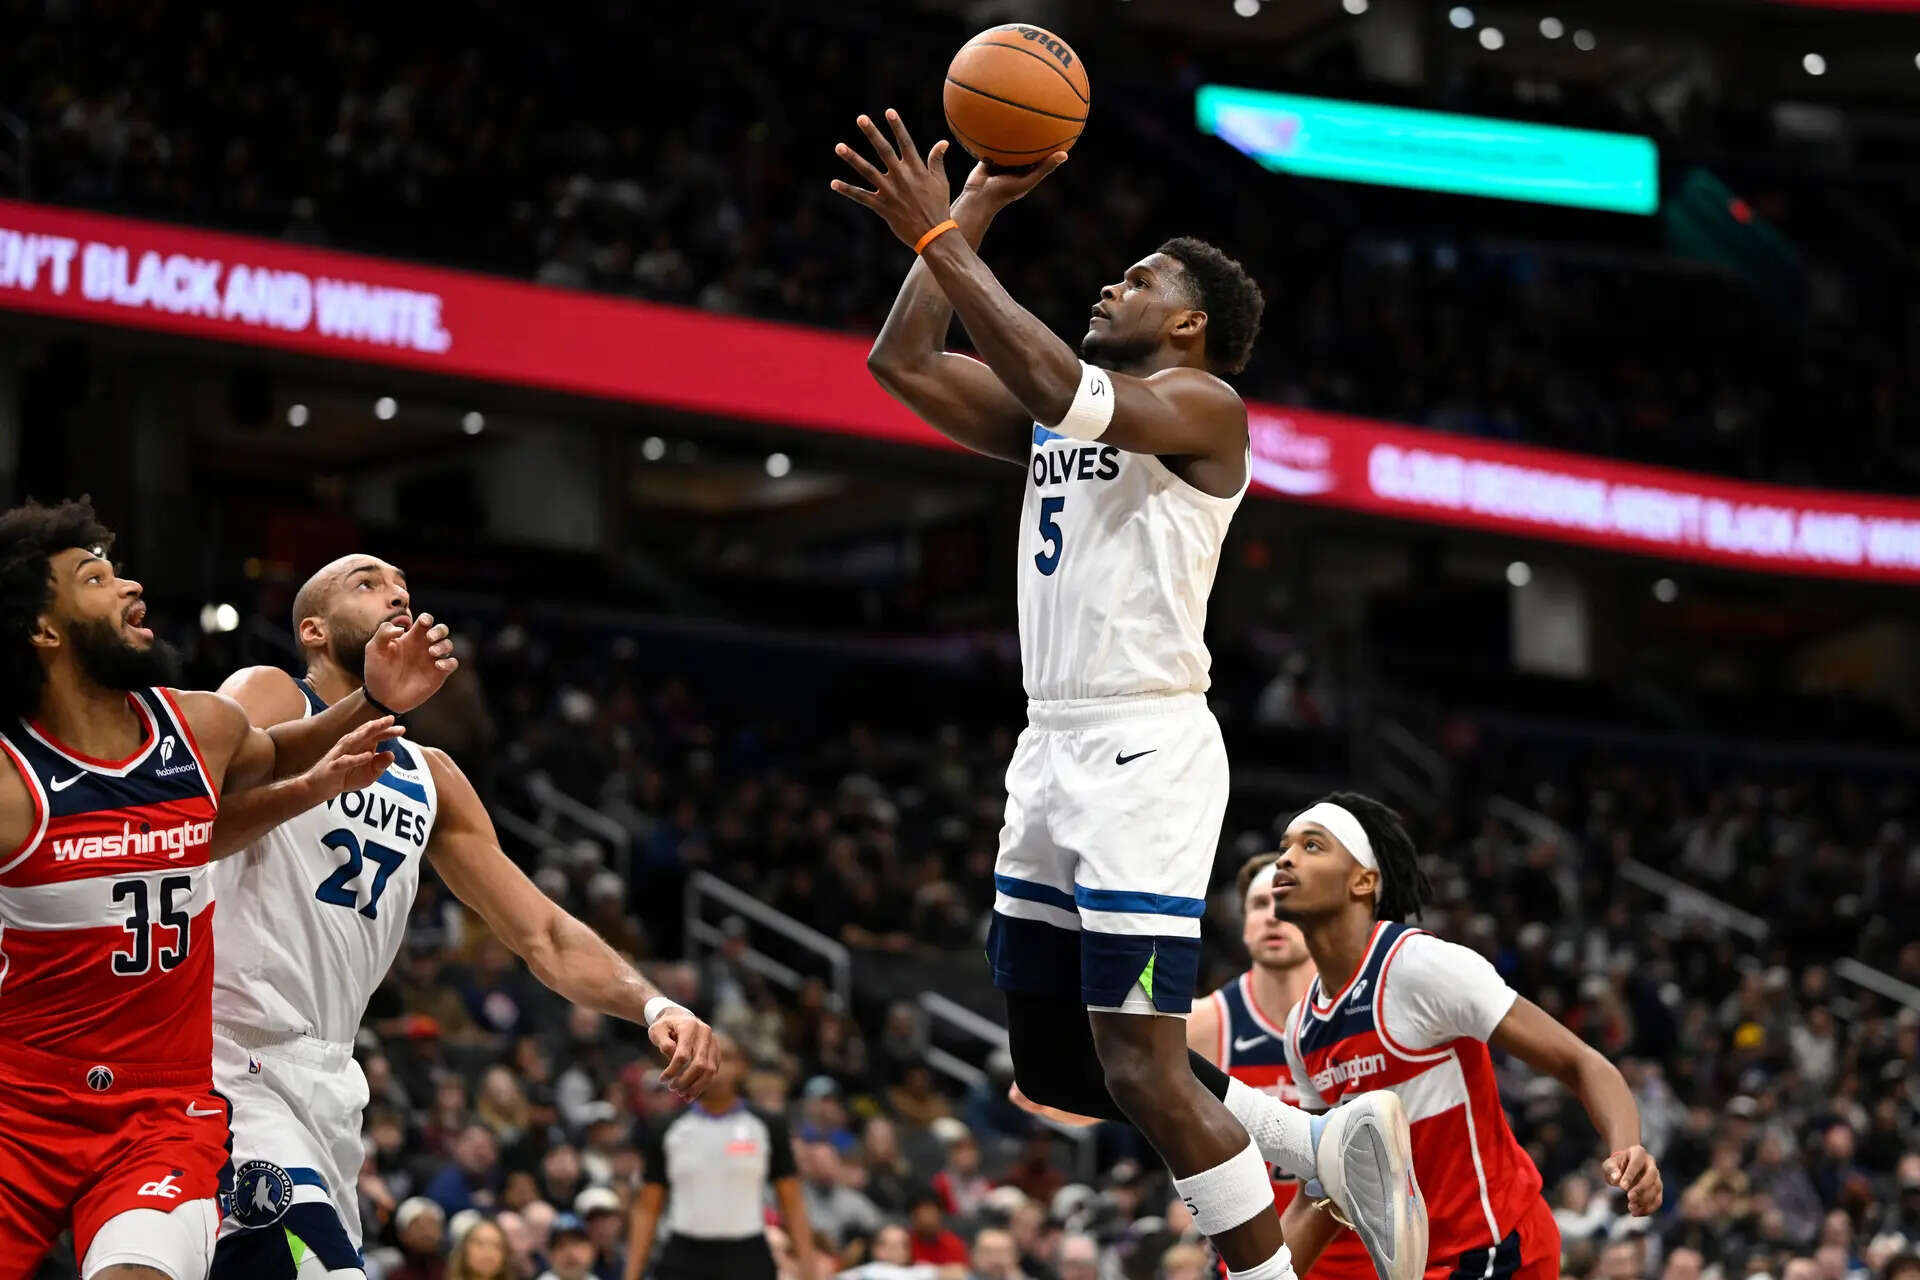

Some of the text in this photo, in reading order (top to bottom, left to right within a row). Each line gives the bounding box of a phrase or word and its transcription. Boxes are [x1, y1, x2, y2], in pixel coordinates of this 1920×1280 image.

[82, 241, 222, 318] BLACK
[222, 263, 312, 332] AND
[1034, 496, 1066, 576] 5
[155, 761, 196, 777] Robinhood
[327, 790, 426, 848] OLVES
[315, 828, 407, 921] 27
[111, 874, 193, 977] 35
[1309, 1053, 1387, 1093] ashington
